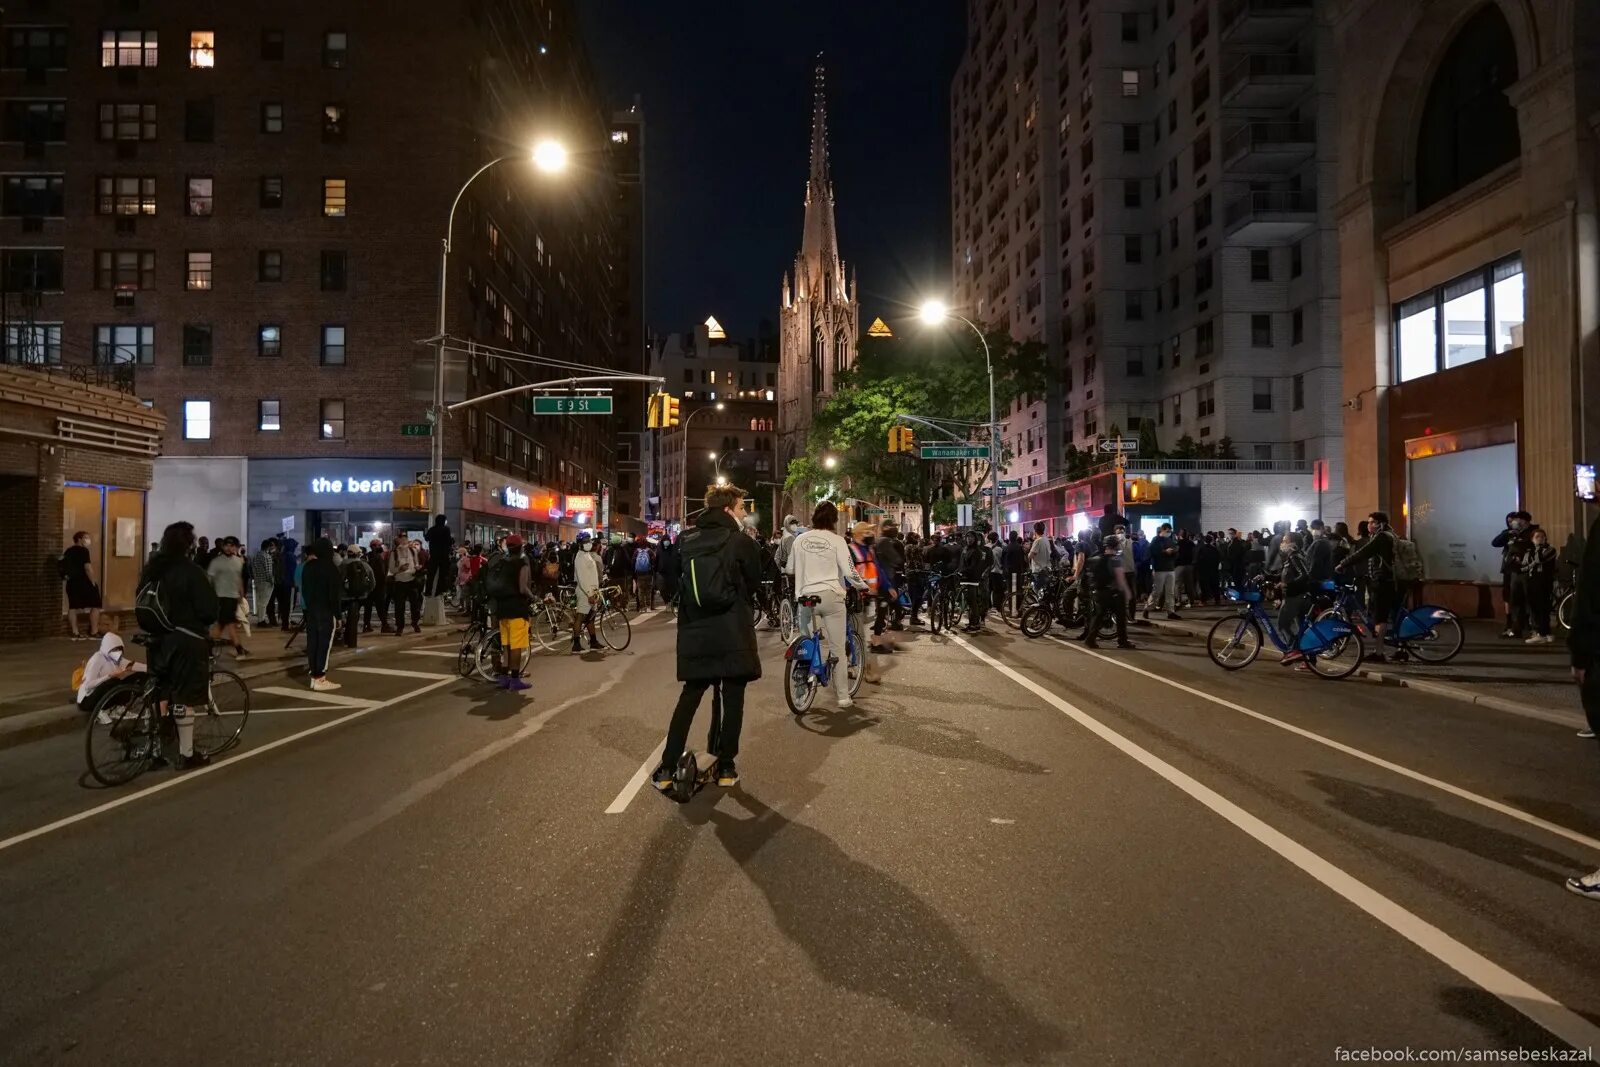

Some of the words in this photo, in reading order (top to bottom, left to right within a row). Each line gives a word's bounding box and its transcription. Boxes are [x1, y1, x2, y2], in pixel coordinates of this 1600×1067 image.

[557, 400, 563, 411] E
[568, 400, 574, 411] 9
[578, 400, 589, 411] St
[407, 425, 412, 435] E
[414, 425, 419, 435] 9
[931, 449, 970, 457] Wanamaker
[312, 477, 343, 493] the
[348, 477, 394, 493] bean
[505, 486, 516, 507] the
[515, 489, 529, 510] bean
